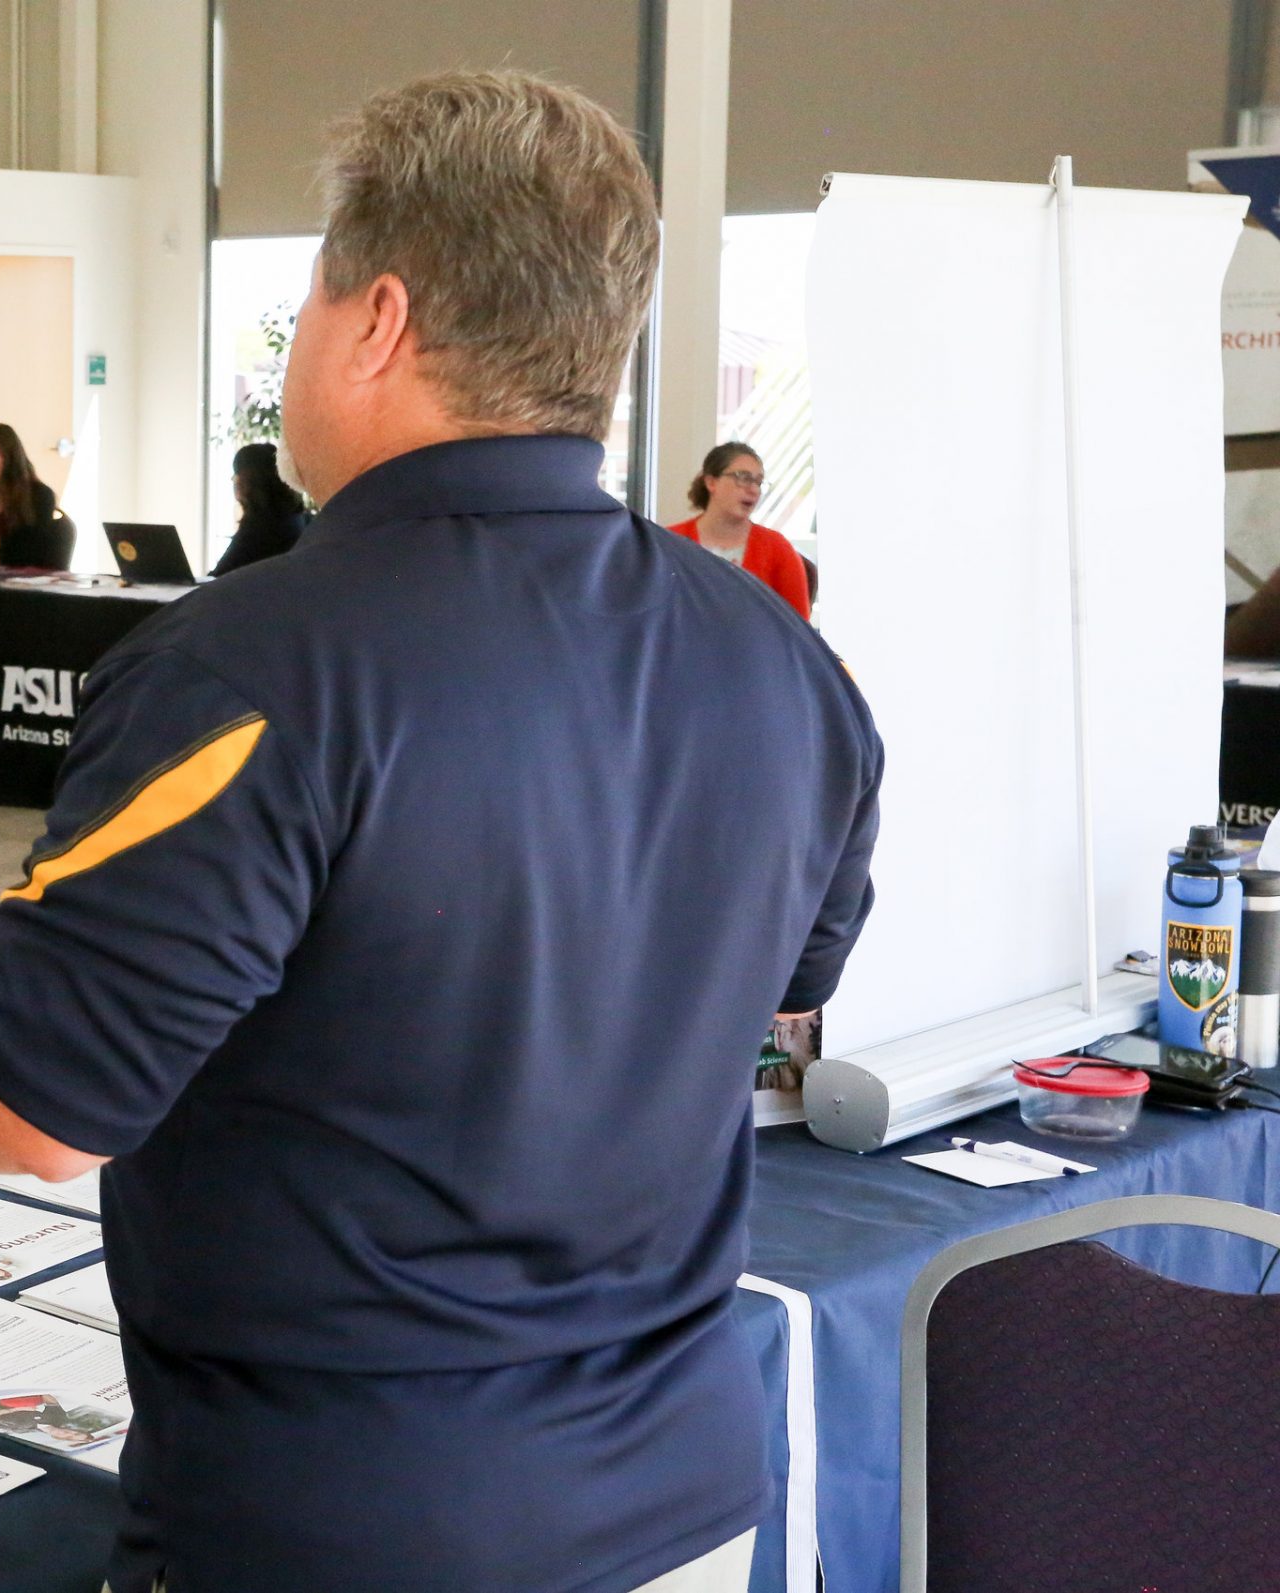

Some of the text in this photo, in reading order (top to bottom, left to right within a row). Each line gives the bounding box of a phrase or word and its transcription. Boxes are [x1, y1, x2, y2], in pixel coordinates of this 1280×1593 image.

[1222, 331, 1280, 350] RCHIT
[1, 665, 75, 717] ASU
[52, 728, 70, 746] St
[1220, 802, 1275, 826] VERS
[1171, 926, 1228, 943] ARIZONA
[1168, 937, 1230, 954] SNOWBOWL
[104, 1388, 129, 1402] ency
